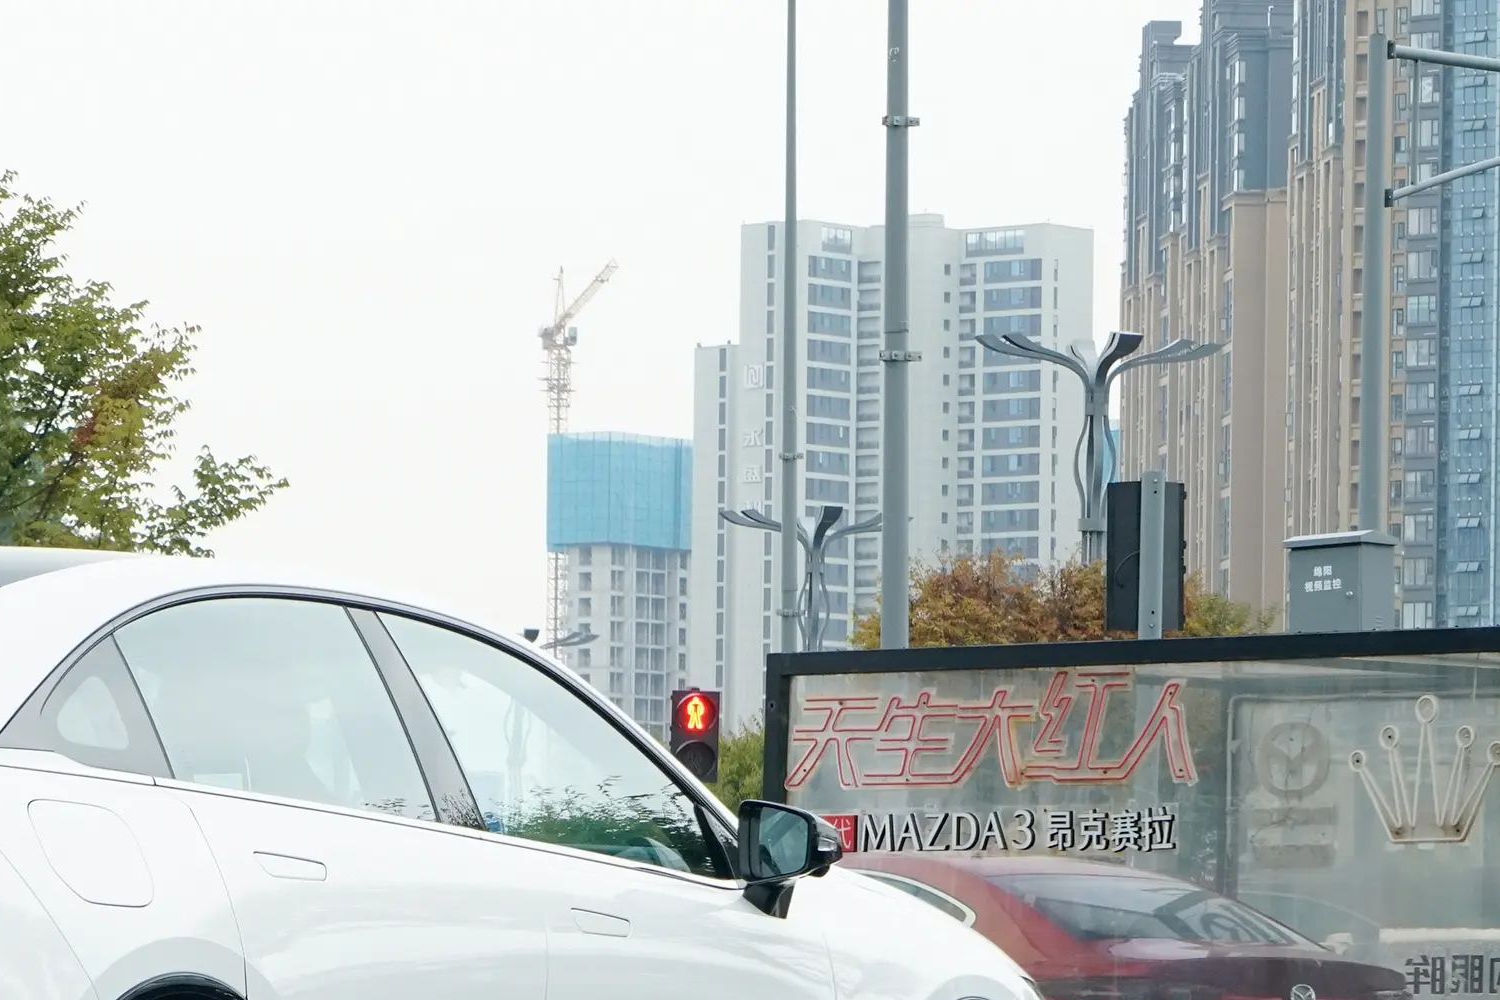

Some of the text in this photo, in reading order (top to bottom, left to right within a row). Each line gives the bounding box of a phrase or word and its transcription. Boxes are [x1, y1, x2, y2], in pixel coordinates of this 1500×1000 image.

[1304, 578, 1342, 592] 视频监控
[784, 670, 1198, 791] 天生大红人
[1047, 806, 1177, 852] 昂克赛拉
